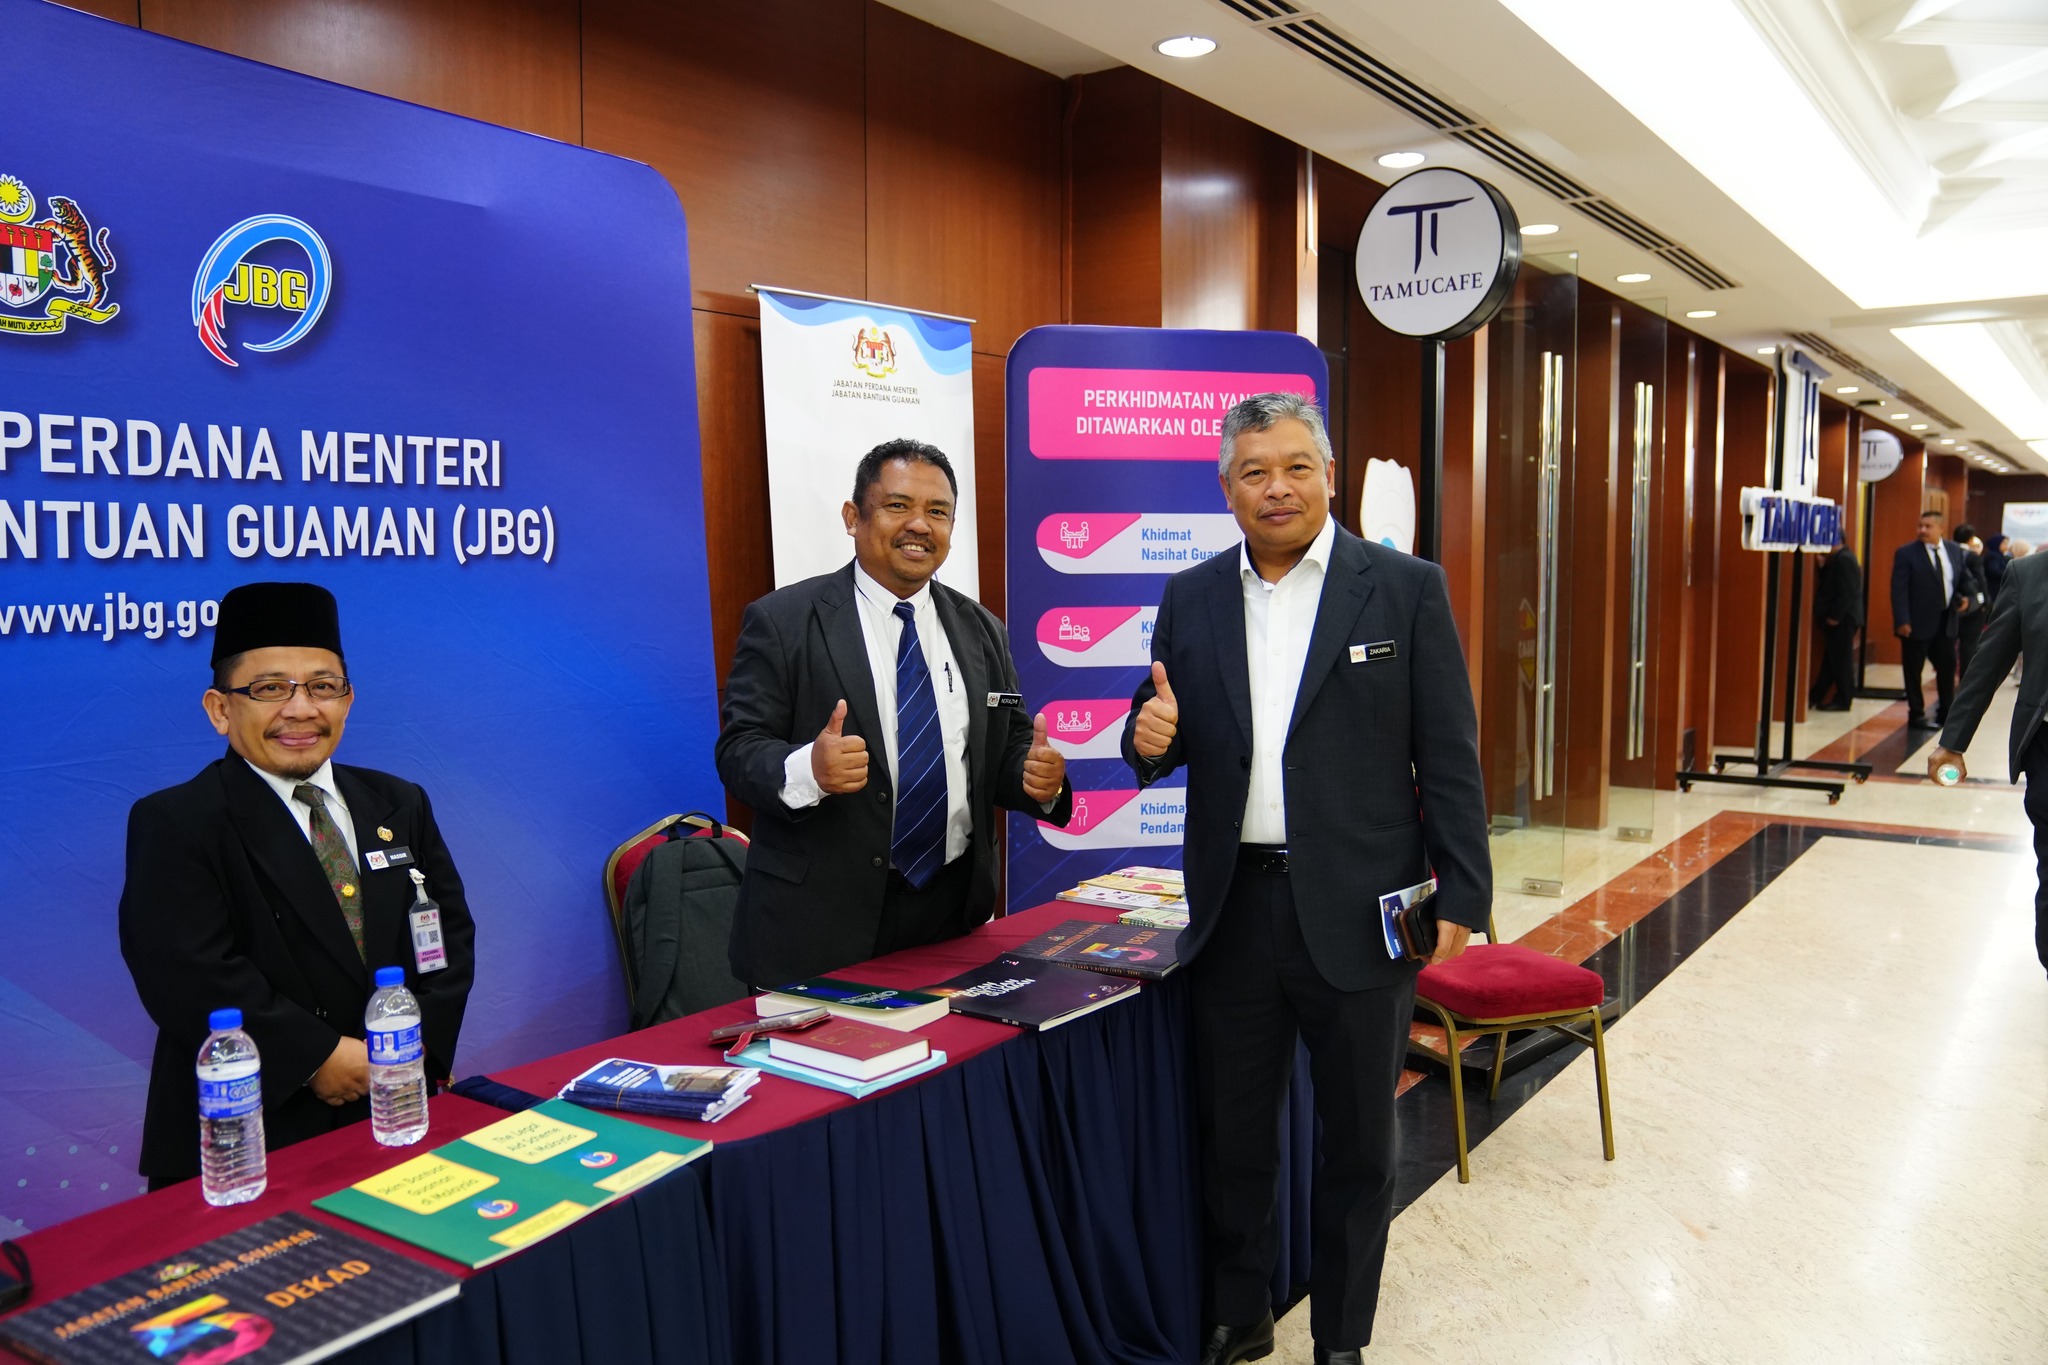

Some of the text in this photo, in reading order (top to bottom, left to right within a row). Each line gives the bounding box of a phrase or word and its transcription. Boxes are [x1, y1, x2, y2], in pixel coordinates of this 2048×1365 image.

[223, 263, 307, 311] JBG
[1370, 272, 1483, 301] TAMUCAFE
[832, 389, 920, 405] JABATAN BANTUAN GUAMAN
[833, 380, 918, 395] JABATAN PERDANA MENTERI
[1084, 389, 1258, 410] PERKHIDMATAN YAN
[1076, 417, 1185, 436] DITAWARKAN
[0, 411, 500, 487] PERDANA MENTERI
[0, 499, 555, 565] NTUAN GUAMAN (JBG)
[1142, 528, 1191, 541] Khidmat
[1142, 548, 1187, 560] Nasihat
[264, 1260, 371, 1309] DEKAD
